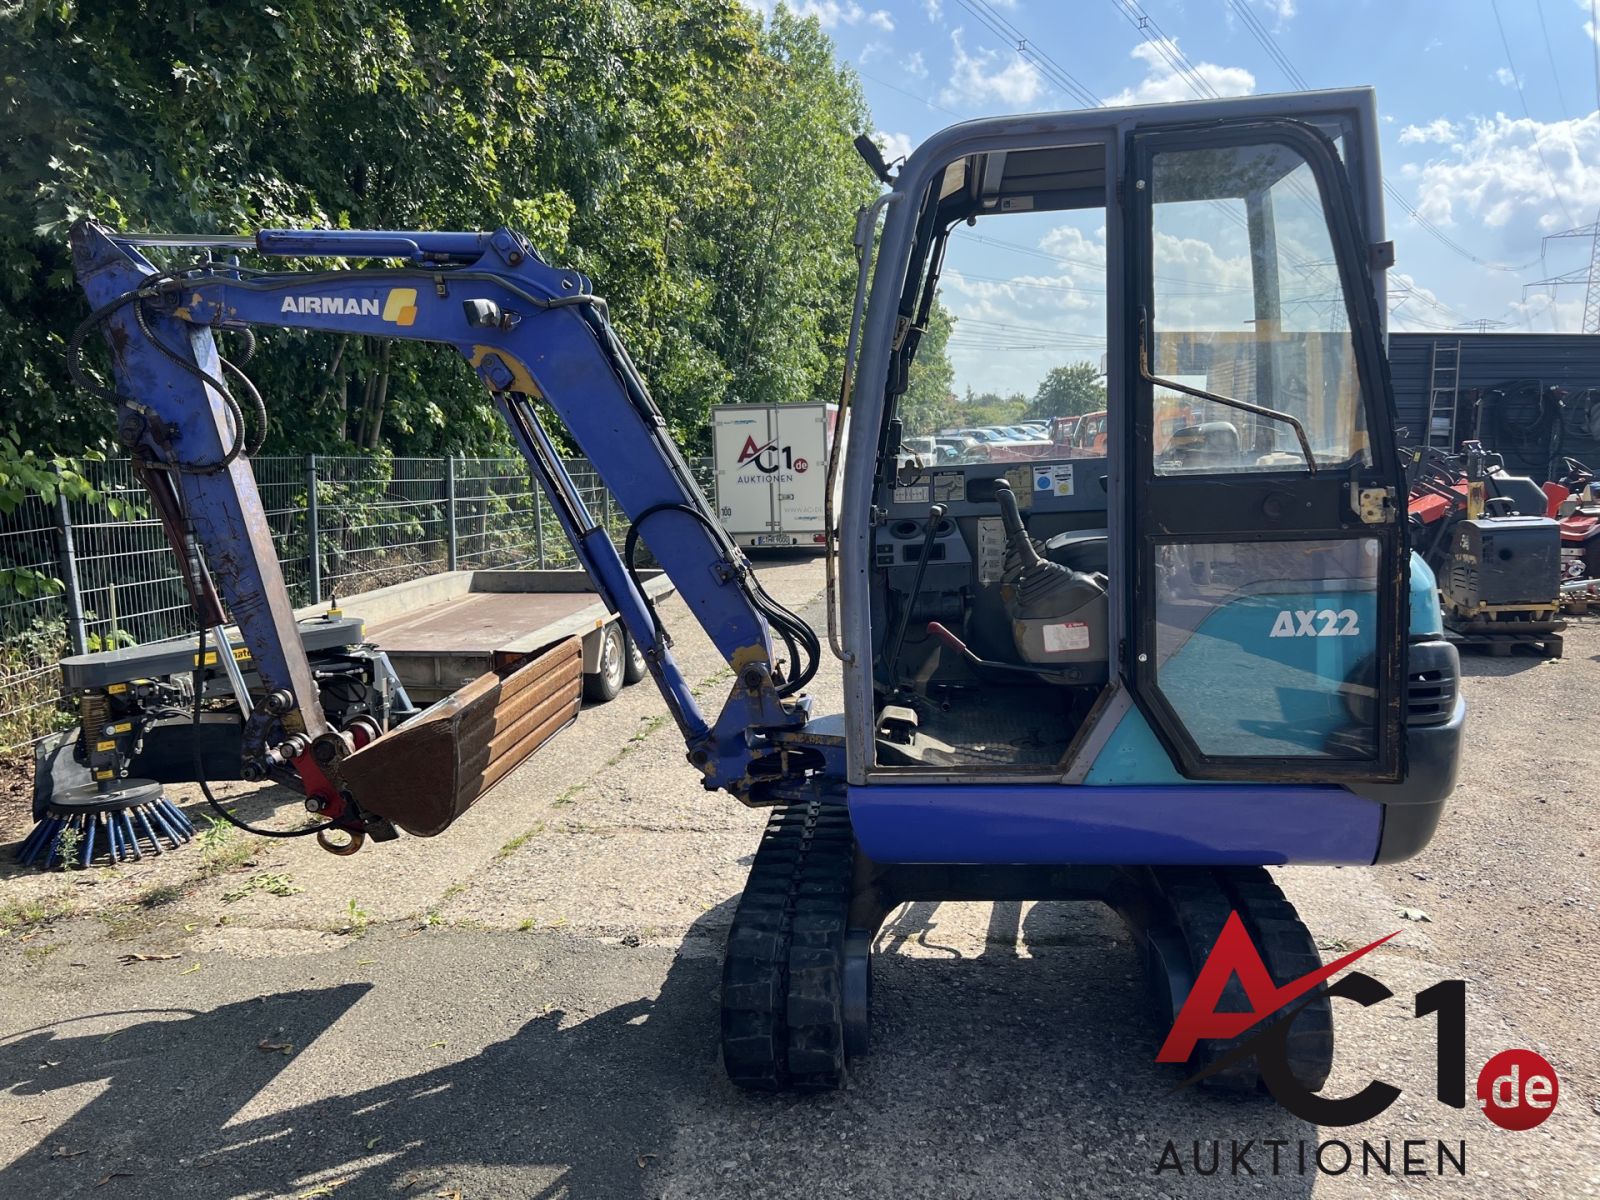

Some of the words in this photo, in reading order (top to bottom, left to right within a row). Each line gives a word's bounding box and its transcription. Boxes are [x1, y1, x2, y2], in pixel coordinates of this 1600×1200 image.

[281, 296, 380, 316] AIRMAN
[738, 475, 793, 484] AUKTIONEN
[1269, 609, 1360, 637] AX22
